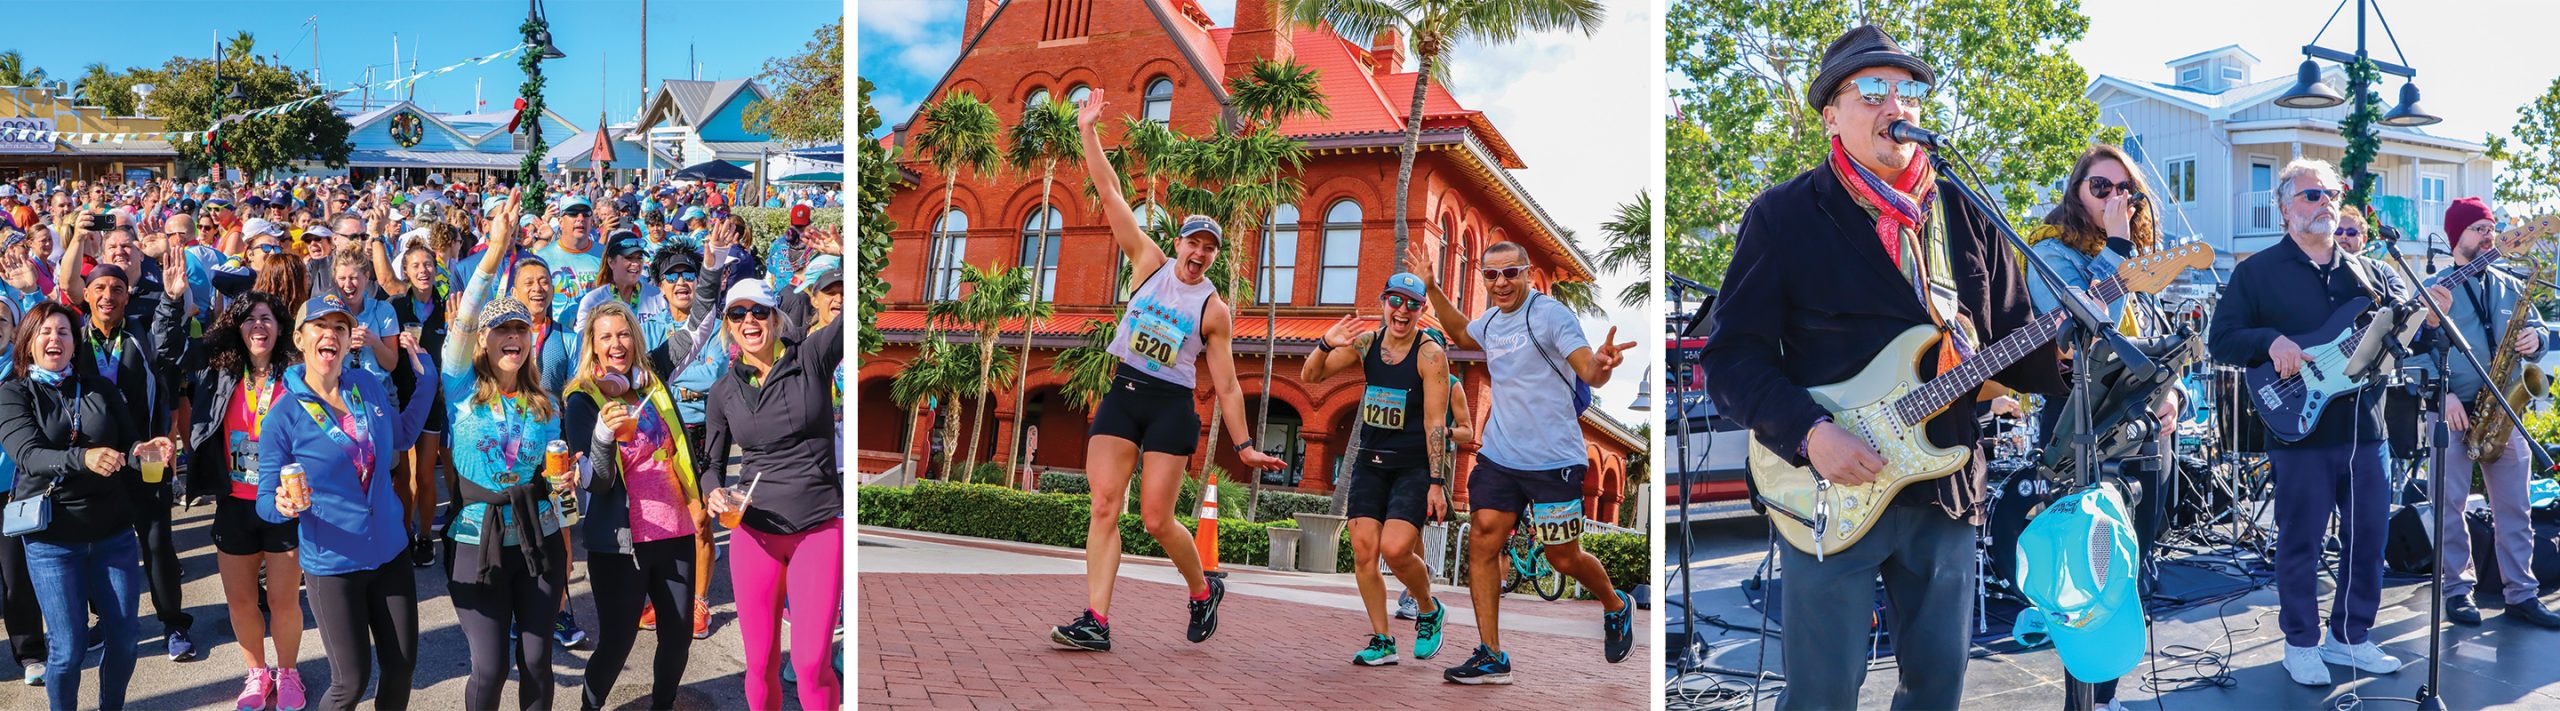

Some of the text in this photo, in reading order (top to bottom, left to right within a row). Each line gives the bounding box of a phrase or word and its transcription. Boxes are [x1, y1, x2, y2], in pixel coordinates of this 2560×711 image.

[0, 121, 49, 131] OCAL
[551, 266, 579, 298] 25
[1135, 331, 1171, 363] 520
[1366, 403, 1401, 427] 1216
[1538, 518, 1580, 541] 1219
